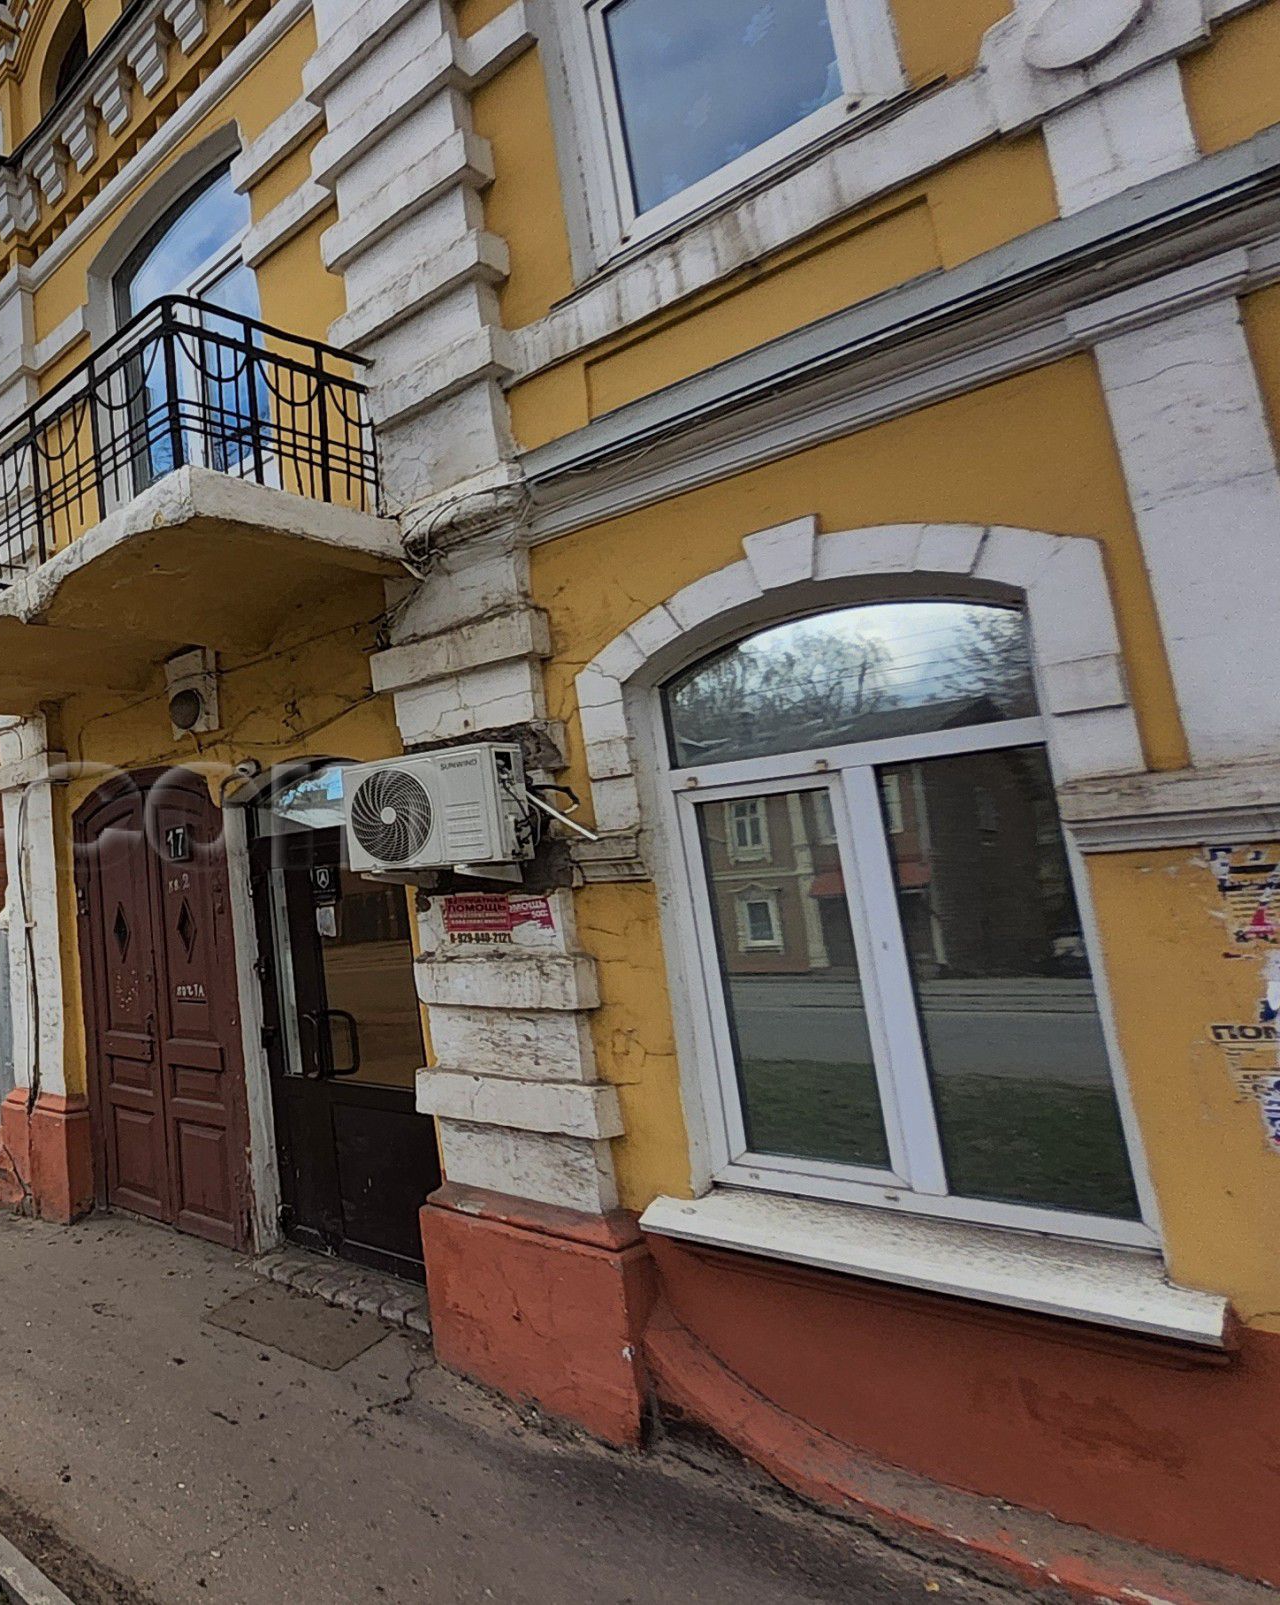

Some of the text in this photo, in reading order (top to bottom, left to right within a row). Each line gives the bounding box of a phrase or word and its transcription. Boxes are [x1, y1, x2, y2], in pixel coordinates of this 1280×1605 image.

[440, 758, 478, 771] SUNWIND
[167, 828, 184, 858] 17
[182, 873, 191, 890] 2
[448, 903, 507, 912] ПОМОЩЬ
